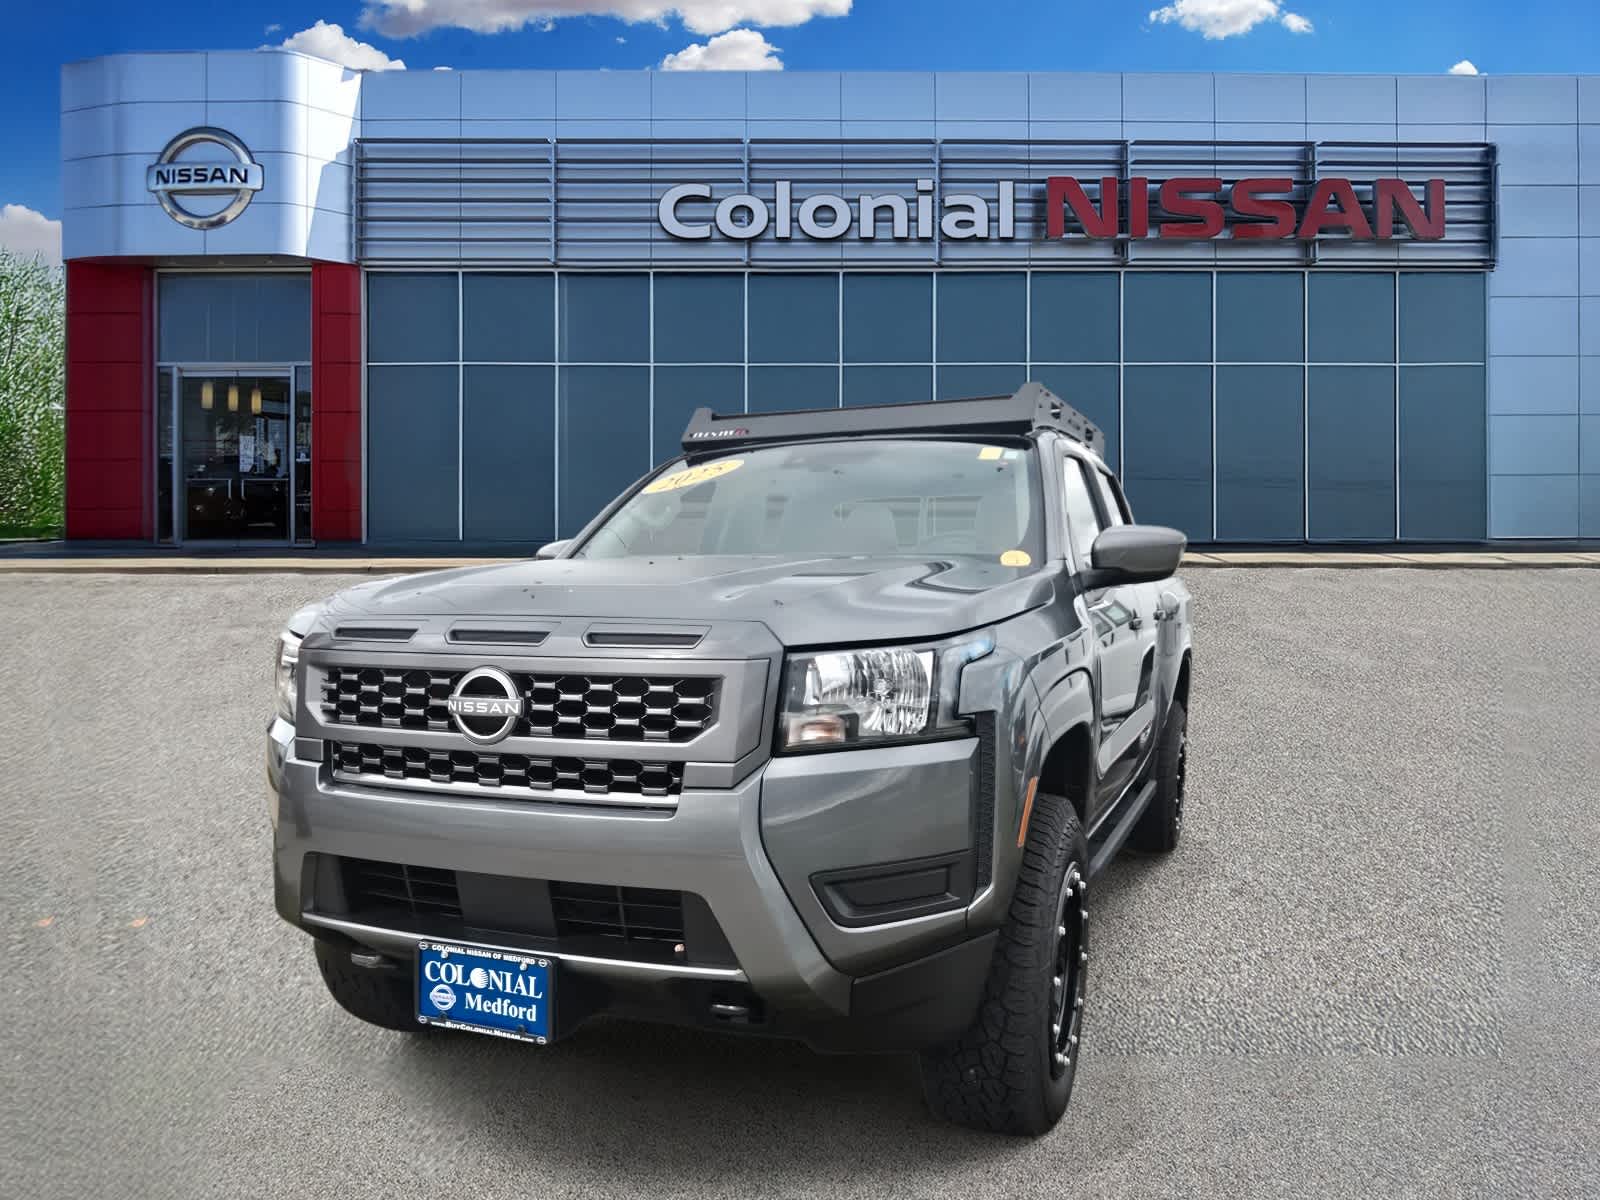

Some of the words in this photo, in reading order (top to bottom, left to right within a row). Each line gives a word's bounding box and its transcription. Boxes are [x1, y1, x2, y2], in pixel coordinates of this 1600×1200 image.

[155, 167, 248, 185] NISSAN
[657, 178, 1015, 240] Colonial
[1045, 176, 1446, 241] NISSAN
[448, 699, 519, 714] NISSAN
[431, 944, 466, 955] COLONIAL
[466, 948, 492, 959] NISSAN
[492, 952, 502, 960] OF
[503, 954, 536, 965] MEDFORD
[424, 960, 543, 999] COLONIAL
[465, 992, 537, 1022] Medford
